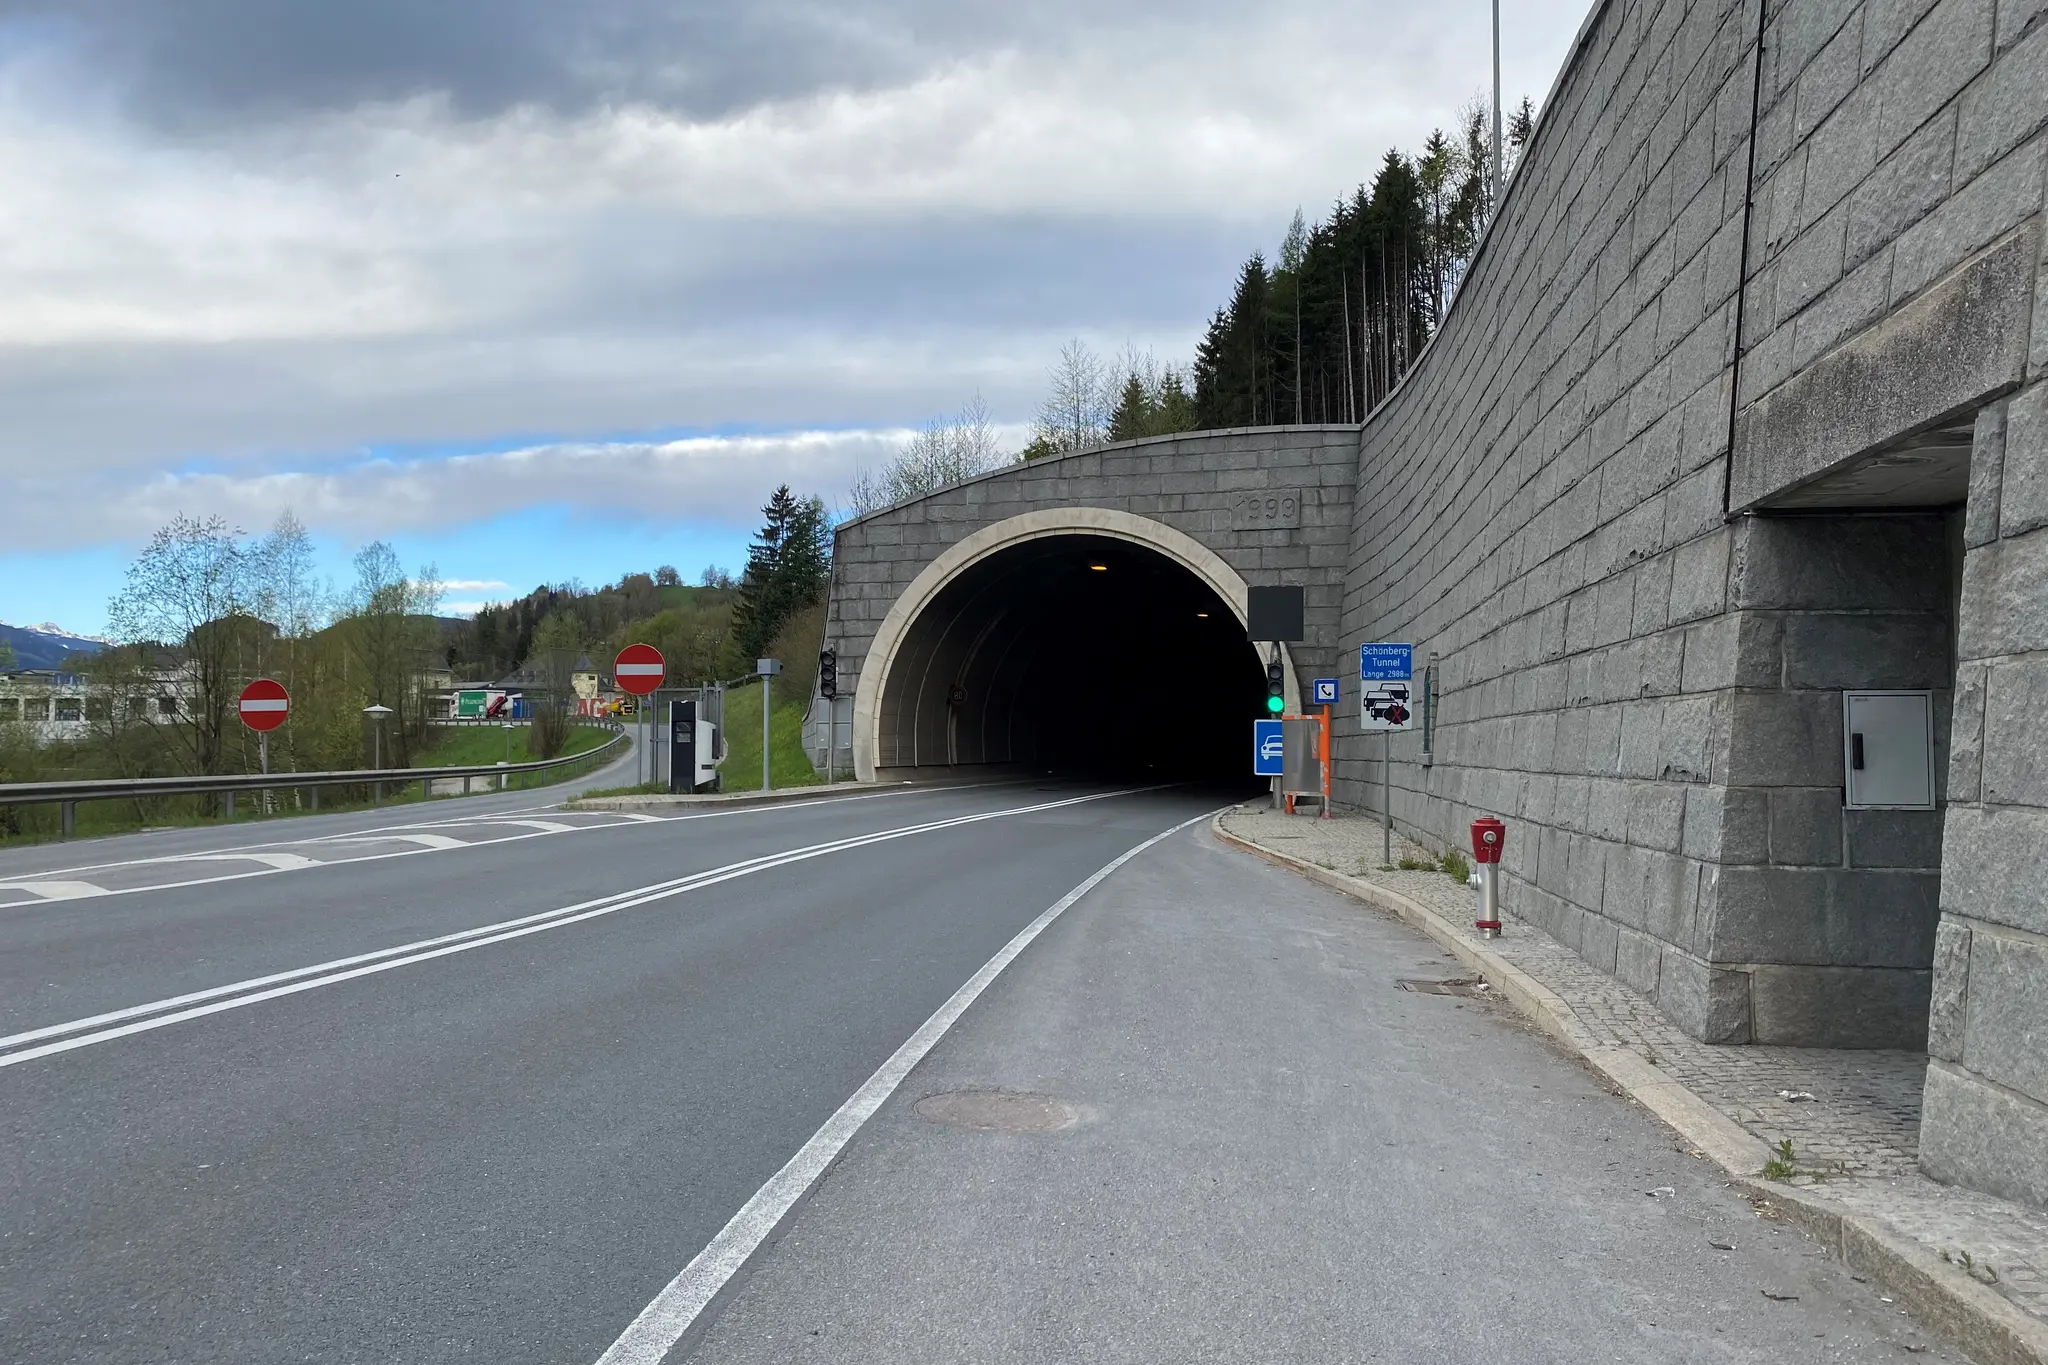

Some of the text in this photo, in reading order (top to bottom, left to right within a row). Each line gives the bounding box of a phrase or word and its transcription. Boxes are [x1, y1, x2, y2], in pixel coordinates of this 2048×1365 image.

[1236, 497, 1296, 520] 1999
[1362, 646, 1410, 657] Schönberg-
[1372, 657, 1400, 667] Tunnel
[953, 691, 963, 700] 80
